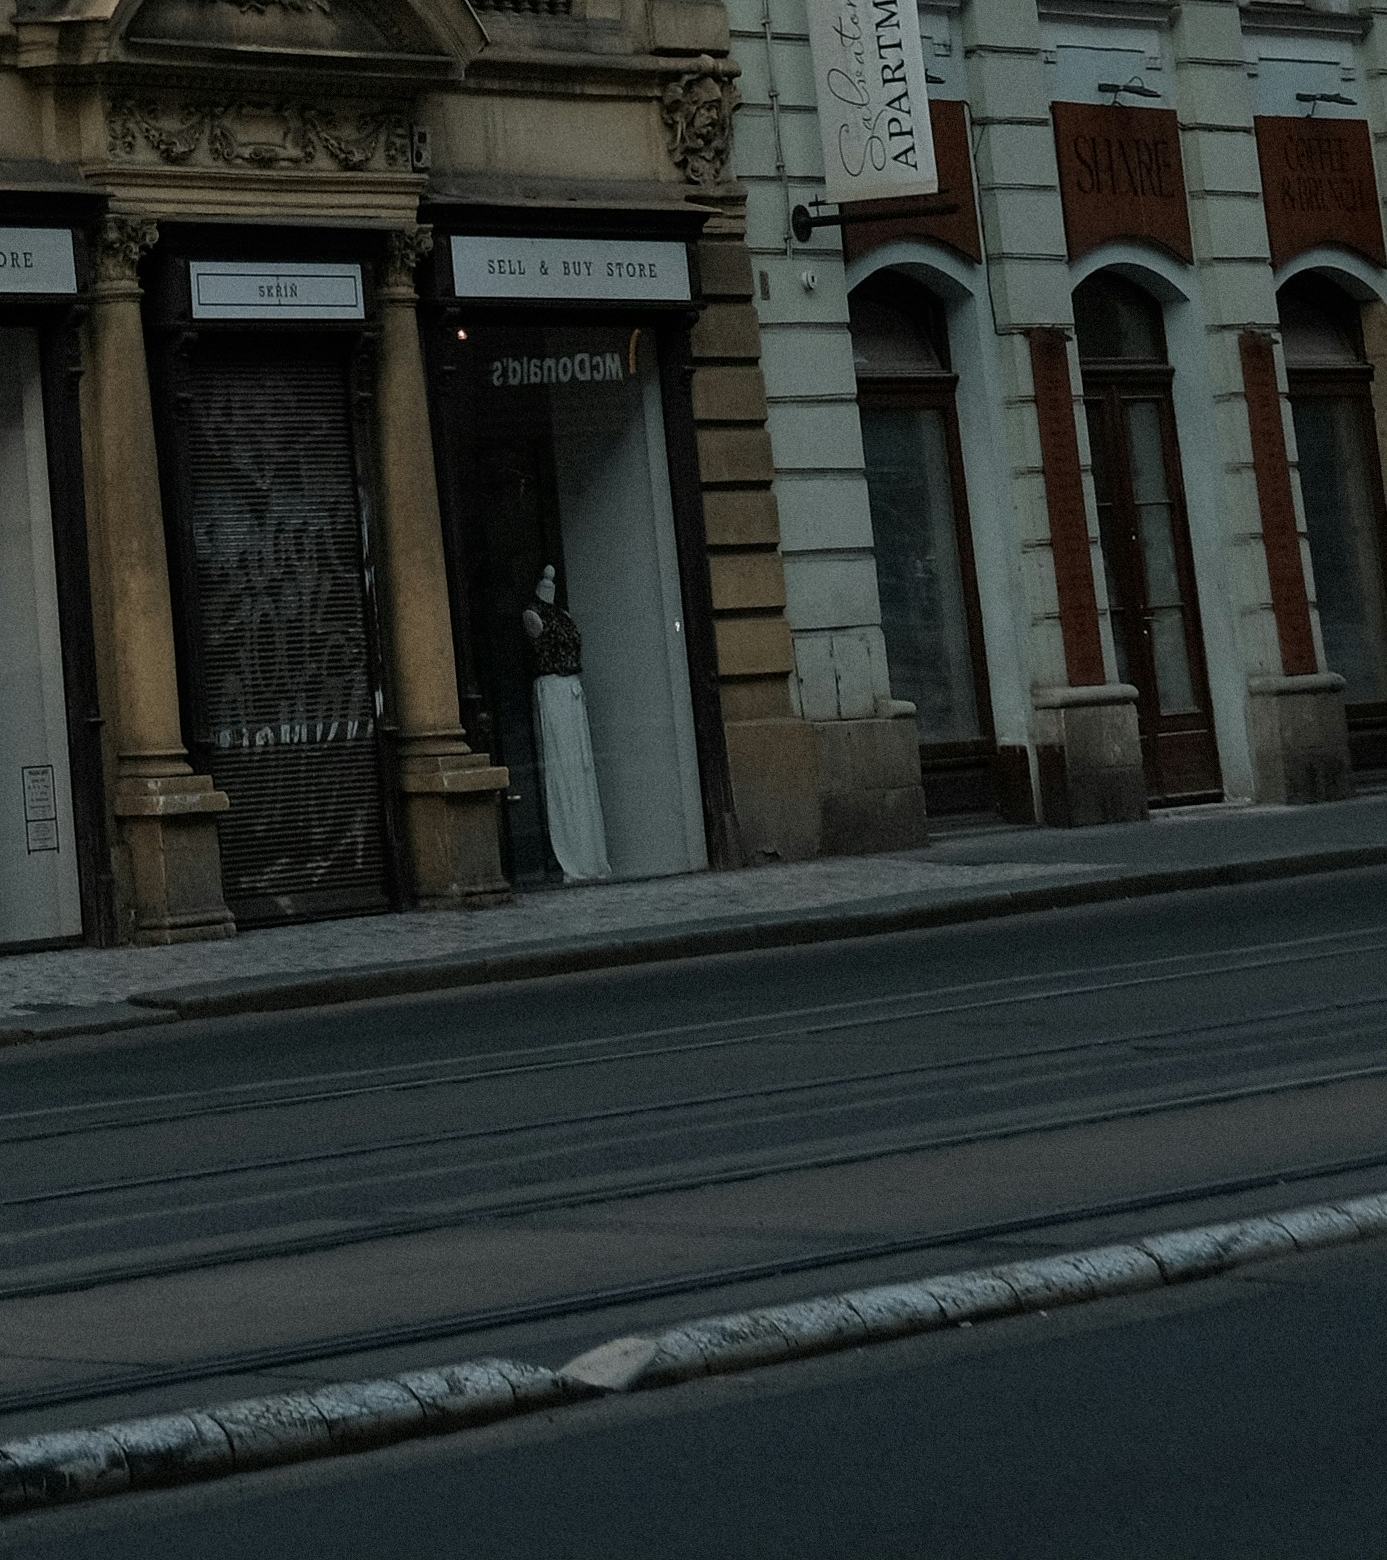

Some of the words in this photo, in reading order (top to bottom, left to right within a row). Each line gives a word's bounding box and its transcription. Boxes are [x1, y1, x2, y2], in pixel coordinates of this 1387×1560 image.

[1074, 135, 1176, 199] SHARE
[487, 259, 526, 275] SELL
[539, 260, 549, 276] &
[563, 261, 593, 277] BUY
[606, 262, 658, 279] STORE
